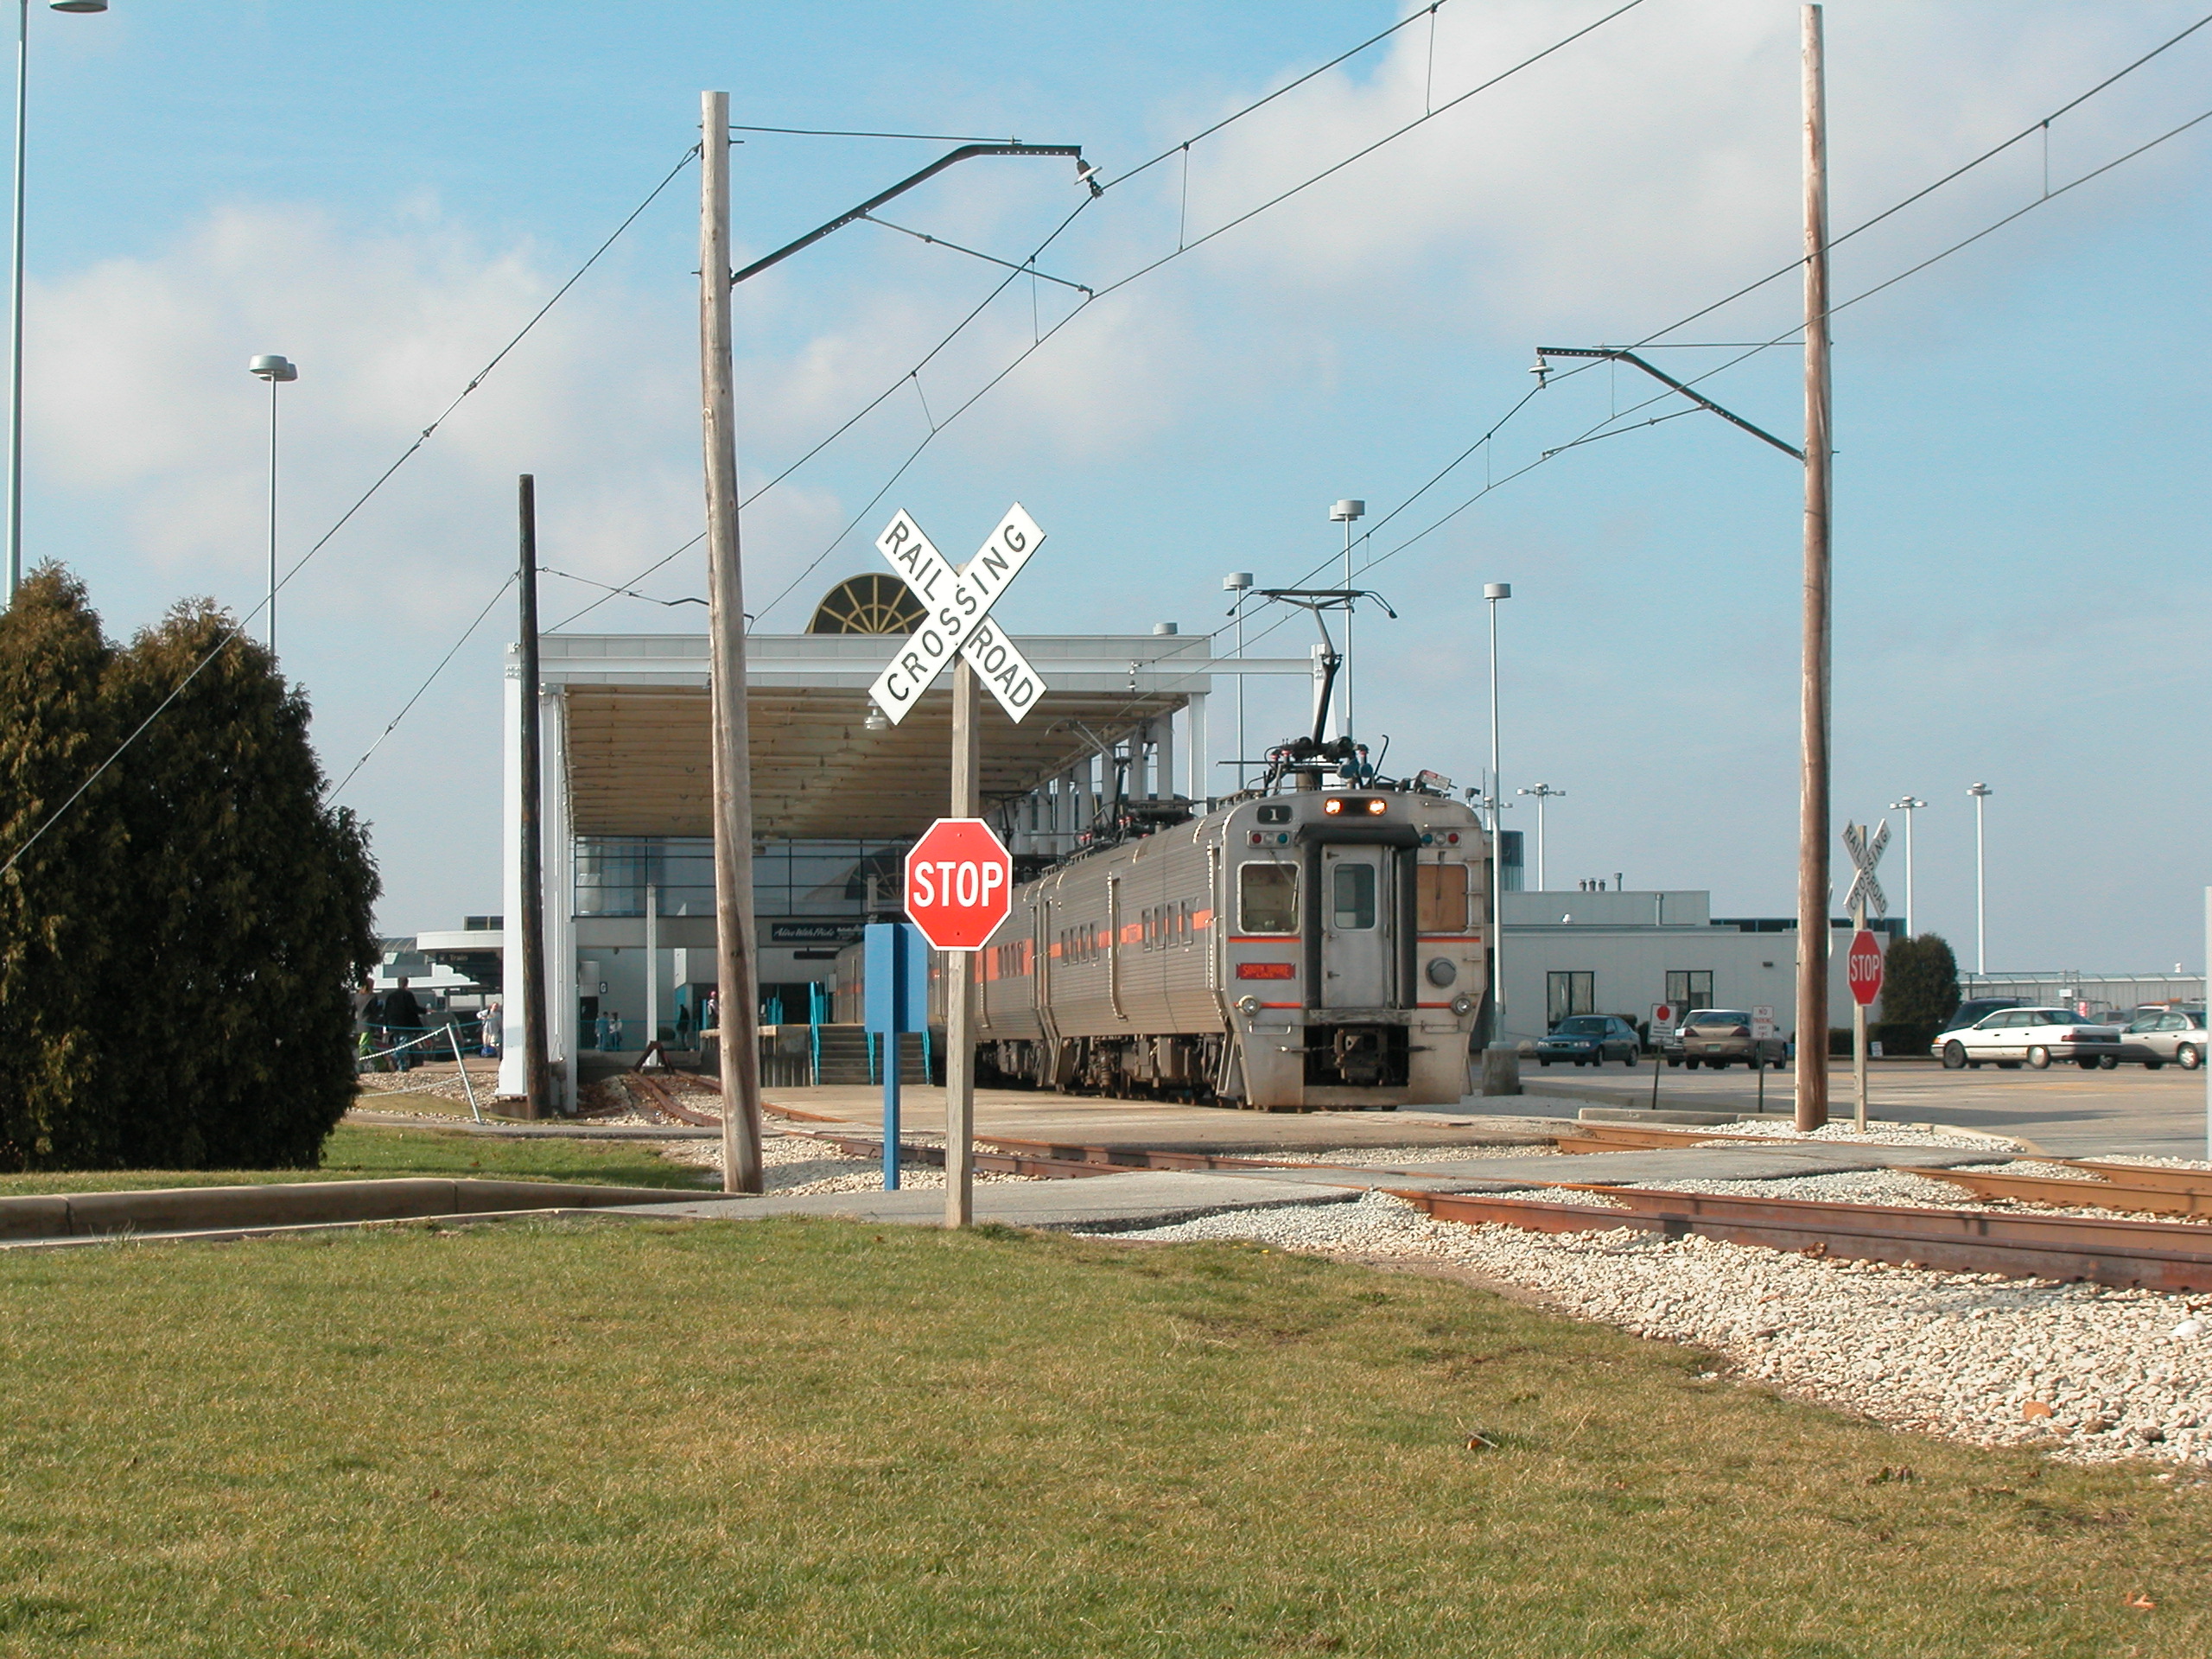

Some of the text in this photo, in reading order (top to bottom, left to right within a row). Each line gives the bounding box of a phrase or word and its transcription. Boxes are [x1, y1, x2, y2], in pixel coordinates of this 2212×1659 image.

[884, 520, 943, 602] RAIL
[887, 524, 1027, 702] CROSSING
[967, 625, 1034, 708] ROAD
[1269, 808, 1280, 822] 1
[1845, 823, 1863, 863] RAIL
[912, 861, 1004, 908] STOP
[1850, 830, 1887, 911] CROSSING
[1867, 874, 1887, 913] ROAD
[600, 982, 607, 993] G
[1850, 954, 1880, 982] STOP
